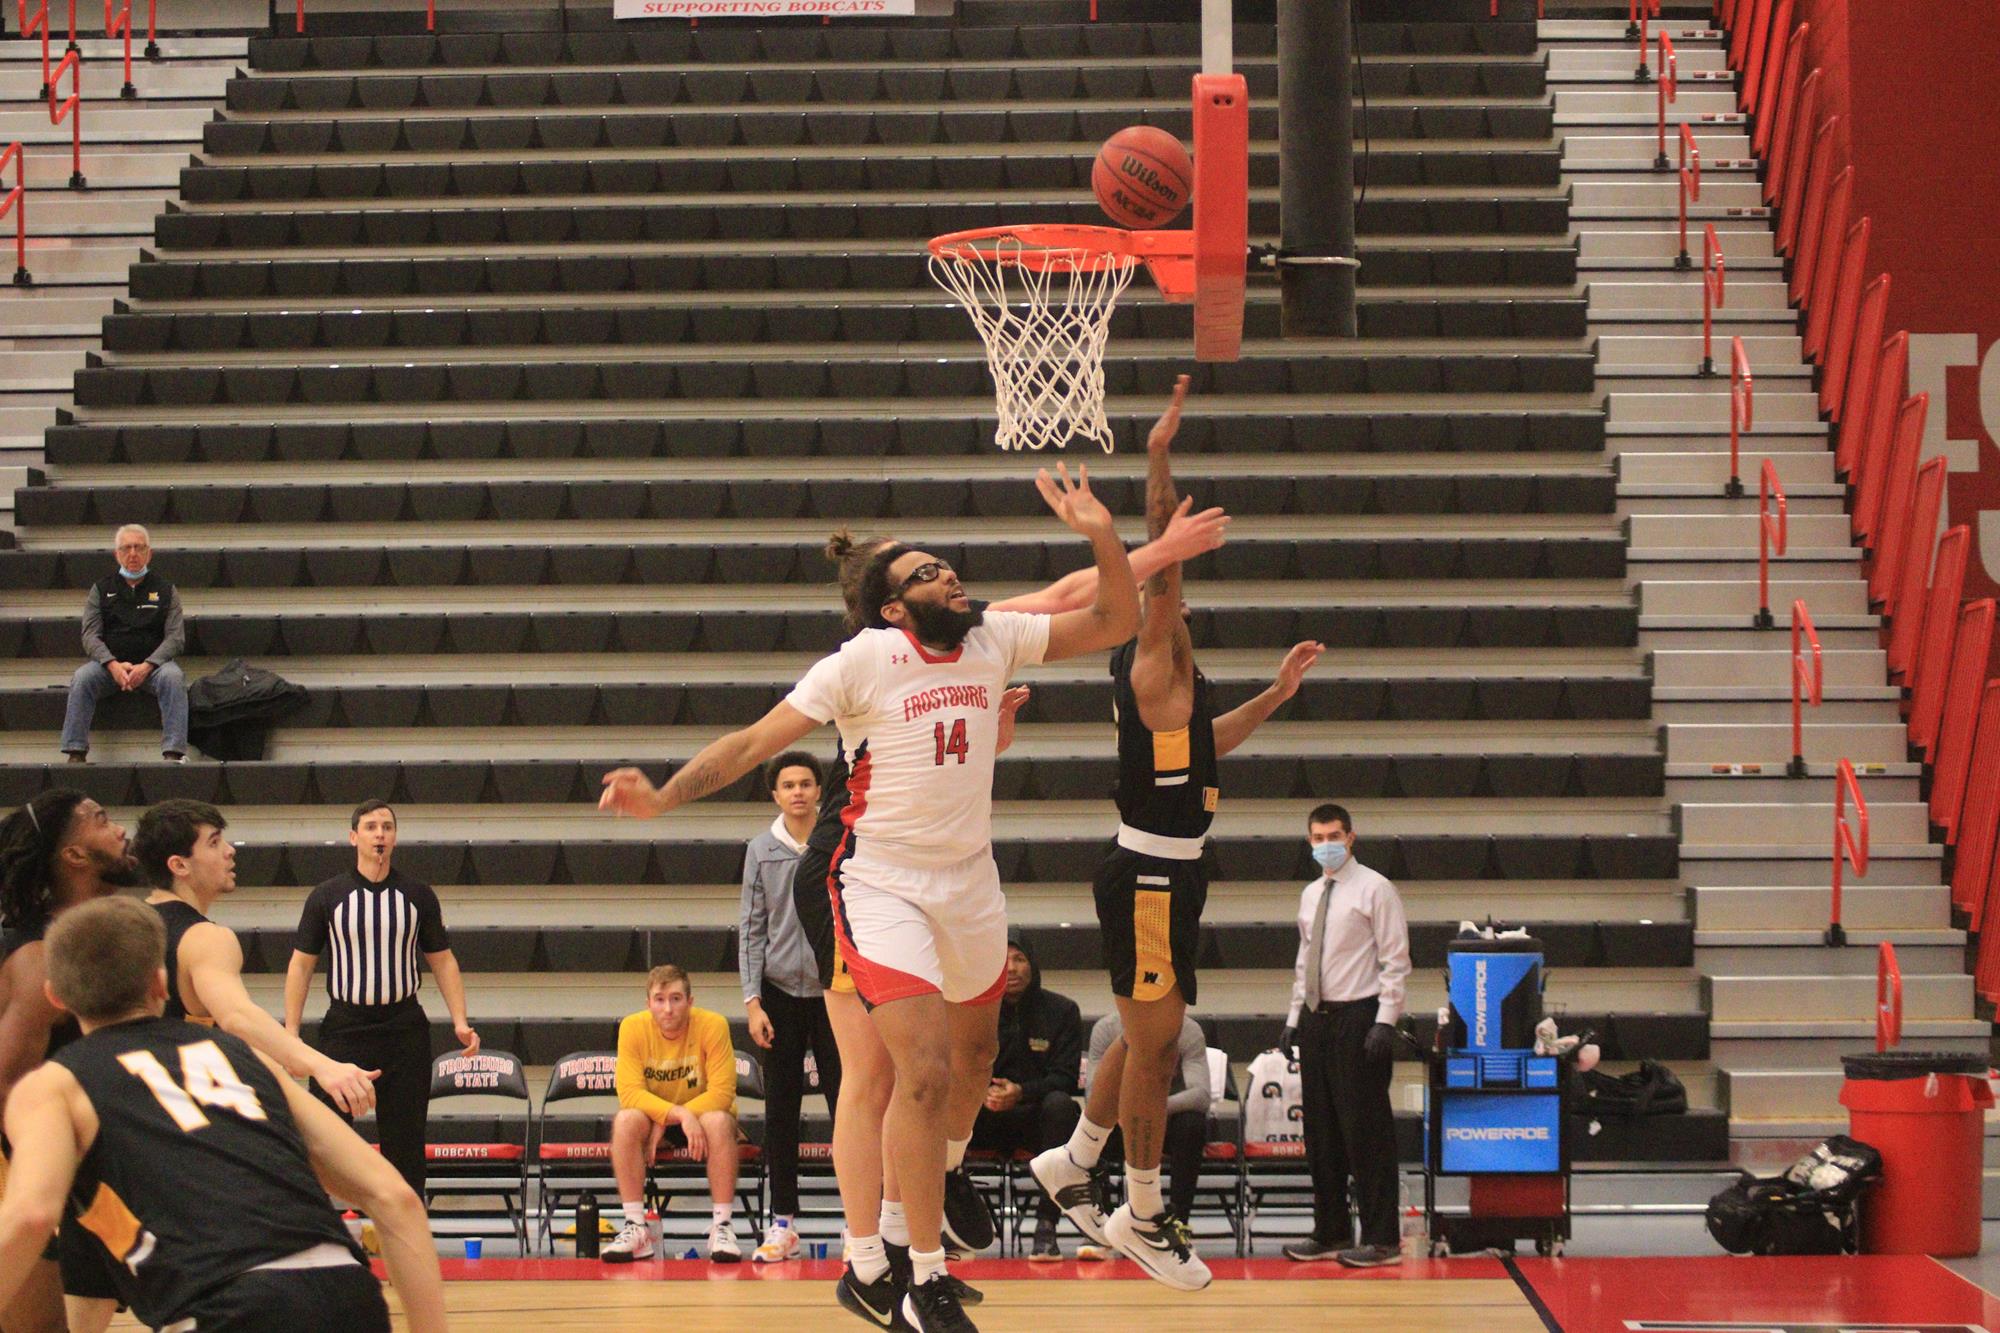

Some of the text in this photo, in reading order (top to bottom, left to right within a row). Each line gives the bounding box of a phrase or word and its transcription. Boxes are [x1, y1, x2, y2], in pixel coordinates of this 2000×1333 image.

[643, 1, 886, 13] SUPPORTING BOBCATS
[1121, 154, 1178, 202] Wilson
[903, 685, 988, 722] FROSTBURG
[934, 718, 969, 766] 14
[1475, 960, 1487, 1047] POWERADE
[438, 1055, 514, 1077] FROSTBURG
[559, 1056, 618, 1079] FROSTBU
[115, 1039, 269, 1133] 14
[454, 1072, 499, 1088] STATE
[1447, 1127, 1550, 1140] POWERADE
[434, 1147, 488, 1157] BOBCATS
[567, 1147, 610, 1157] BOBCAT
